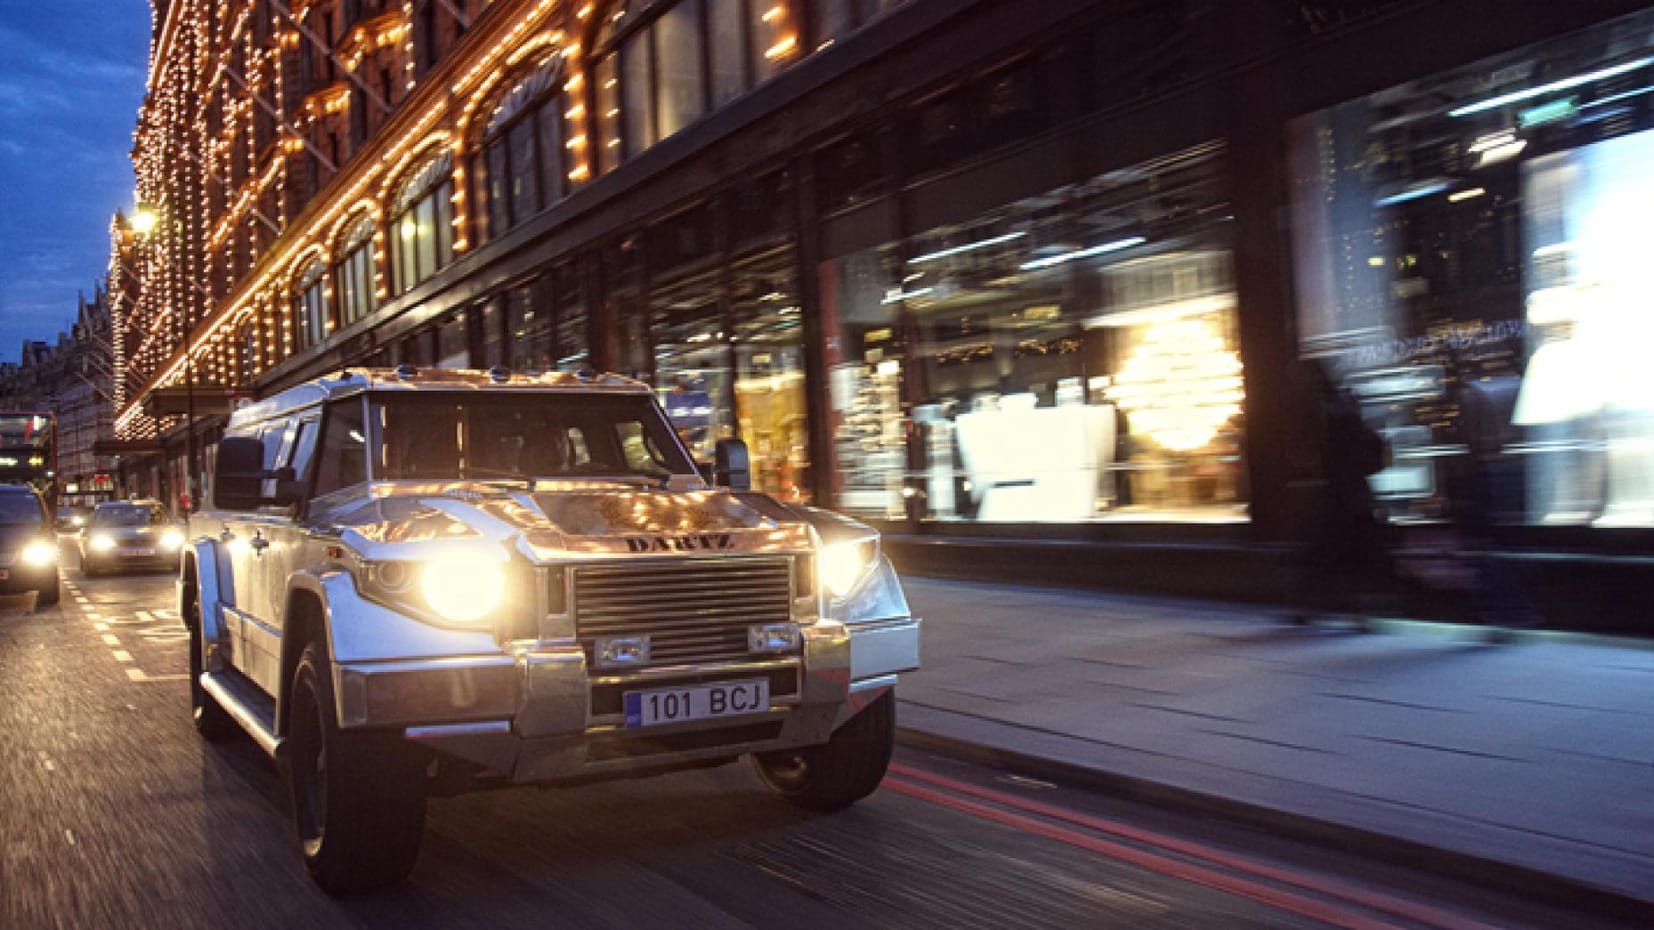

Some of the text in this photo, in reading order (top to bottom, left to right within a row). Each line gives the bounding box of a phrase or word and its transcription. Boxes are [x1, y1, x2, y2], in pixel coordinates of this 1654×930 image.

[626, 534, 734, 552] DARTZ
[650, 692, 691, 721] 101
[710, 685, 760, 714] BCJ
